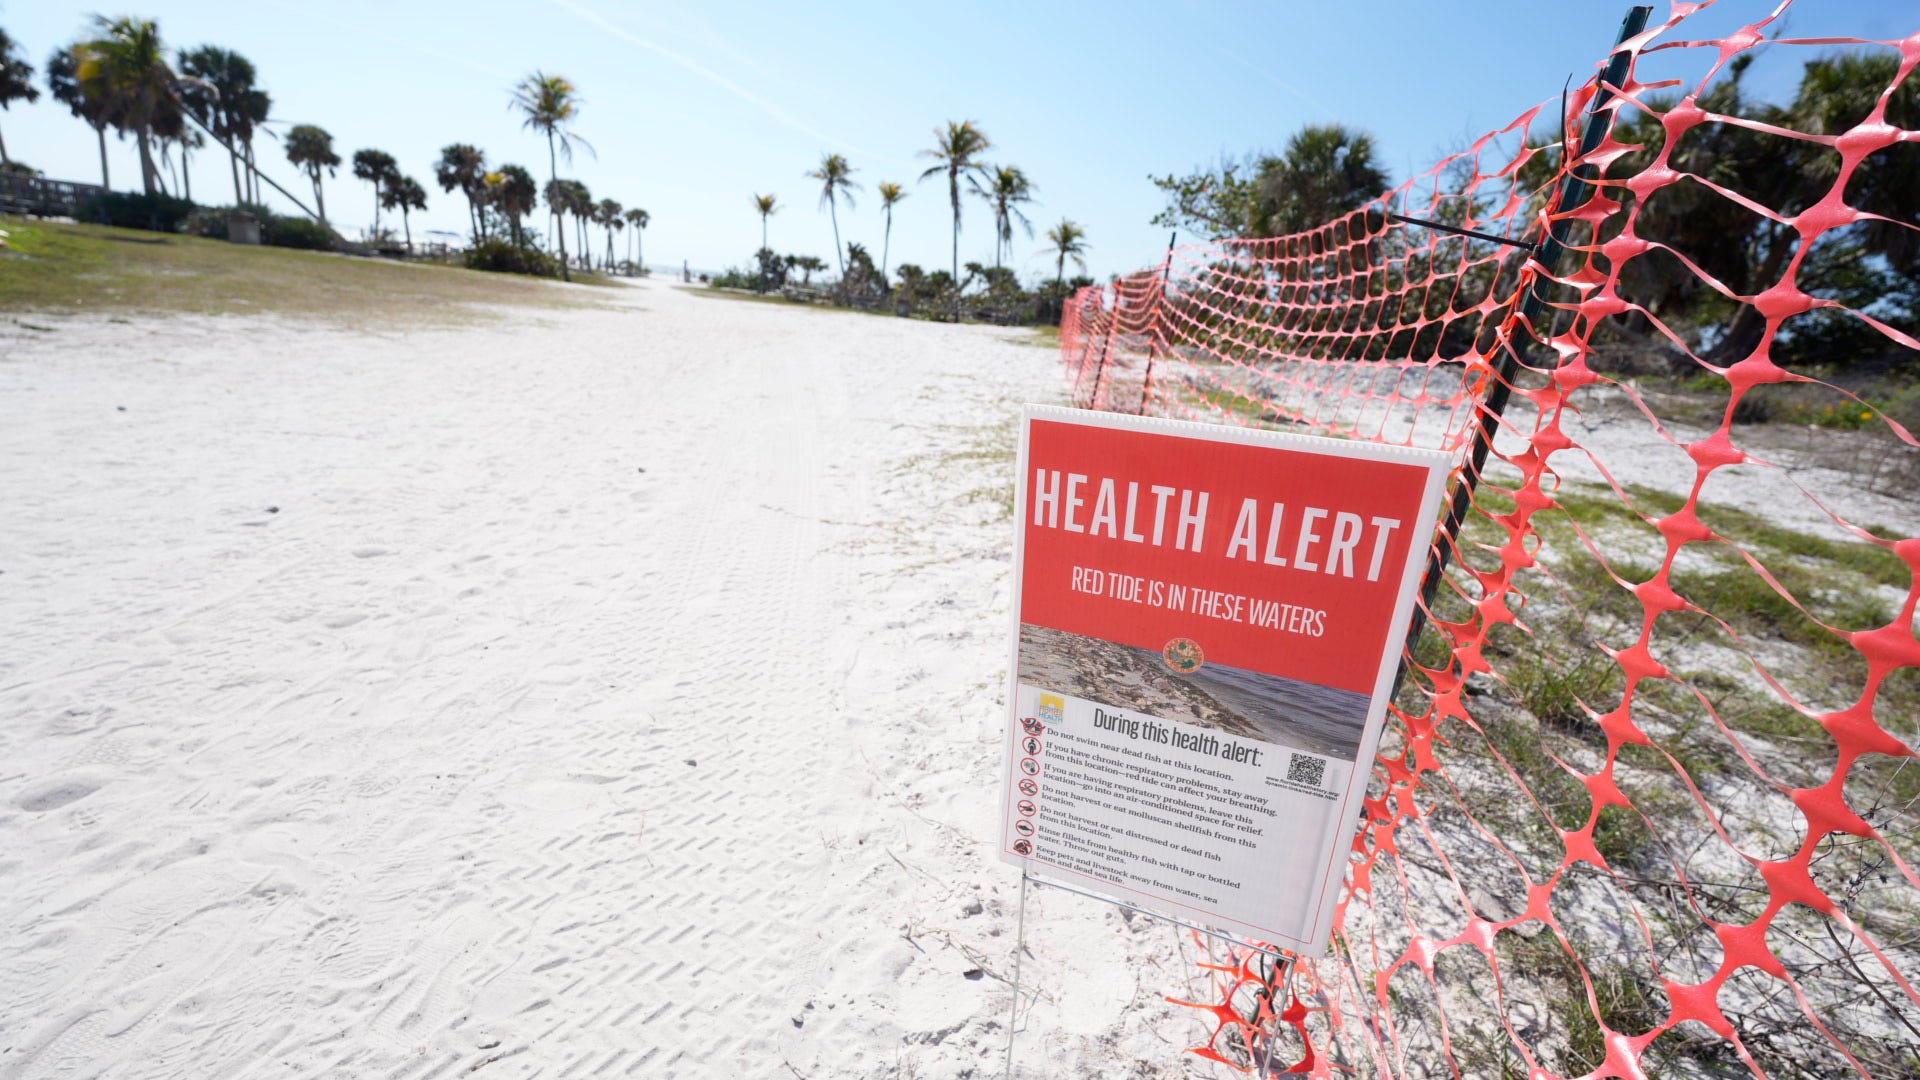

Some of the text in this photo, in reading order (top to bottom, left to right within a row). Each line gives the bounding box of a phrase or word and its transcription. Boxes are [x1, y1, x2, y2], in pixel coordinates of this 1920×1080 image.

[1034, 468, 1401, 582] HEALTH ALERT
[1071, 566, 1327, 637] RED TIDE IS IN THESE WATERS
[1038, 712, 1063, 723] HEALTH
[1093, 708, 1264, 767] During this health alert:
[1045, 741, 1269, 806] If you have chronic respiratory problems, stay away
[1045, 749, 1065, 761] from
[1066, 756, 1083, 766] this
[1141, 776, 1159, 786] tide
[1160, 780, 1176, 790] can
[1178, 783, 1205, 798] affect
[1206, 792, 1228, 803] your
[1229, 797, 1278, 817] breathing.
[1047, 727, 1059, 737] Do
[1060, 732, 1074, 741] not
[1076, 737, 1099, 747] swim
[1100, 743, 1121, 753] near
[1121, 747, 1143, 759] dead
[1144, 752, 1161, 763] fish
[1174, 760, 1192, 771] this
[1193, 764, 1234, 781] location.
[1041, 792, 1076, 808] location.
[1042, 784, 1054, 793] Do
[1055, 789, 1069, 797] not
[1070, 792, 1101, 806] harvest
[1113, 805, 1127, 813] eat
[1128, 809, 1173, 826] molluscan
[1174, 821, 1212, 837] shellfish
[1214, 831, 1236, 844] from
[1238, 838, 1256, 849] this
[1044, 763, 1253, 825] If you are having respiratory problems, leave this
[1094, 785, 1112, 796] into
[1125, 792, 1194, 818] air-conditioned
[1194, 813, 1220, 825] space
[1221, 819, 1236, 829] for
[1236, 825, 1263, 837] relief.
[1037, 834, 1126, 865] water. Throw out guts.
[1039, 812, 1113, 840] from this location.
[1040, 805, 1052, 814] Do
[1053, 810, 1067, 818] not
[1068, 812, 1099, 827] harvest
[1110, 826, 1124, 834] eat
[1125, 830, 1169, 847] distressed
[1181, 845, 1203, 857] dead
[1204, 851, 1221, 862] fish
[1036, 852, 1124, 885] foam and dead sea life.
[1036, 844, 1218, 904] Keep pets and livestock away from water, sea
[1038, 825, 1061, 837] Rinse
[1062, 832, 1085, 844] fillets
[1087, 839, 1107, 851] from
[1108, 845, 1140, 861] healthy
[1141, 855, 1158, 865] fish
[1159, 861, 1179, 872] with
[1180, 867, 1195, 877] tap
[1208, 874, 1241, 889] bottled
